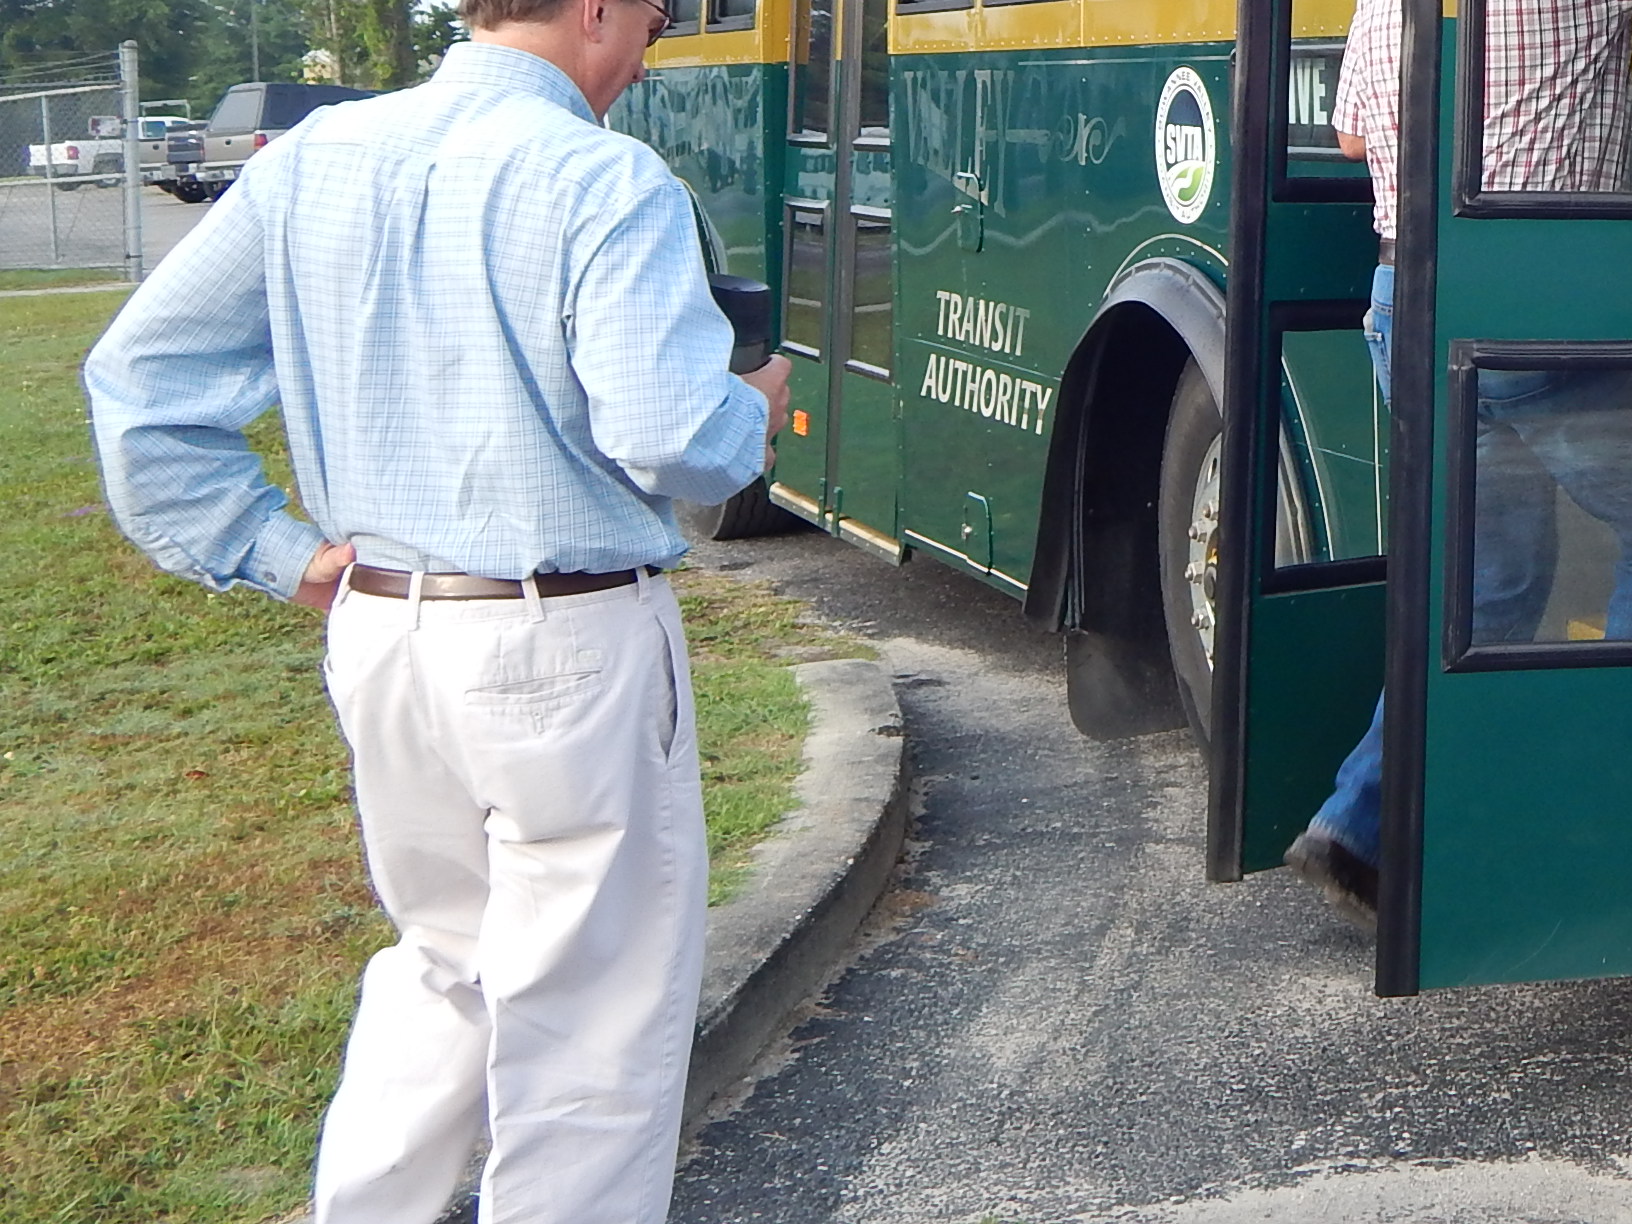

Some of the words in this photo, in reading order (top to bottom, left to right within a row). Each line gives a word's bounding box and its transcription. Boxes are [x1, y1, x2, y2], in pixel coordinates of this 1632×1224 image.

[1289, 57, 1328, 125] IVE
[1166, 123, 1204, 164] SVTA
[936, 290, 1031, 357] TRANSIT
[920, 353, 1053, 435] AUTHORITY
